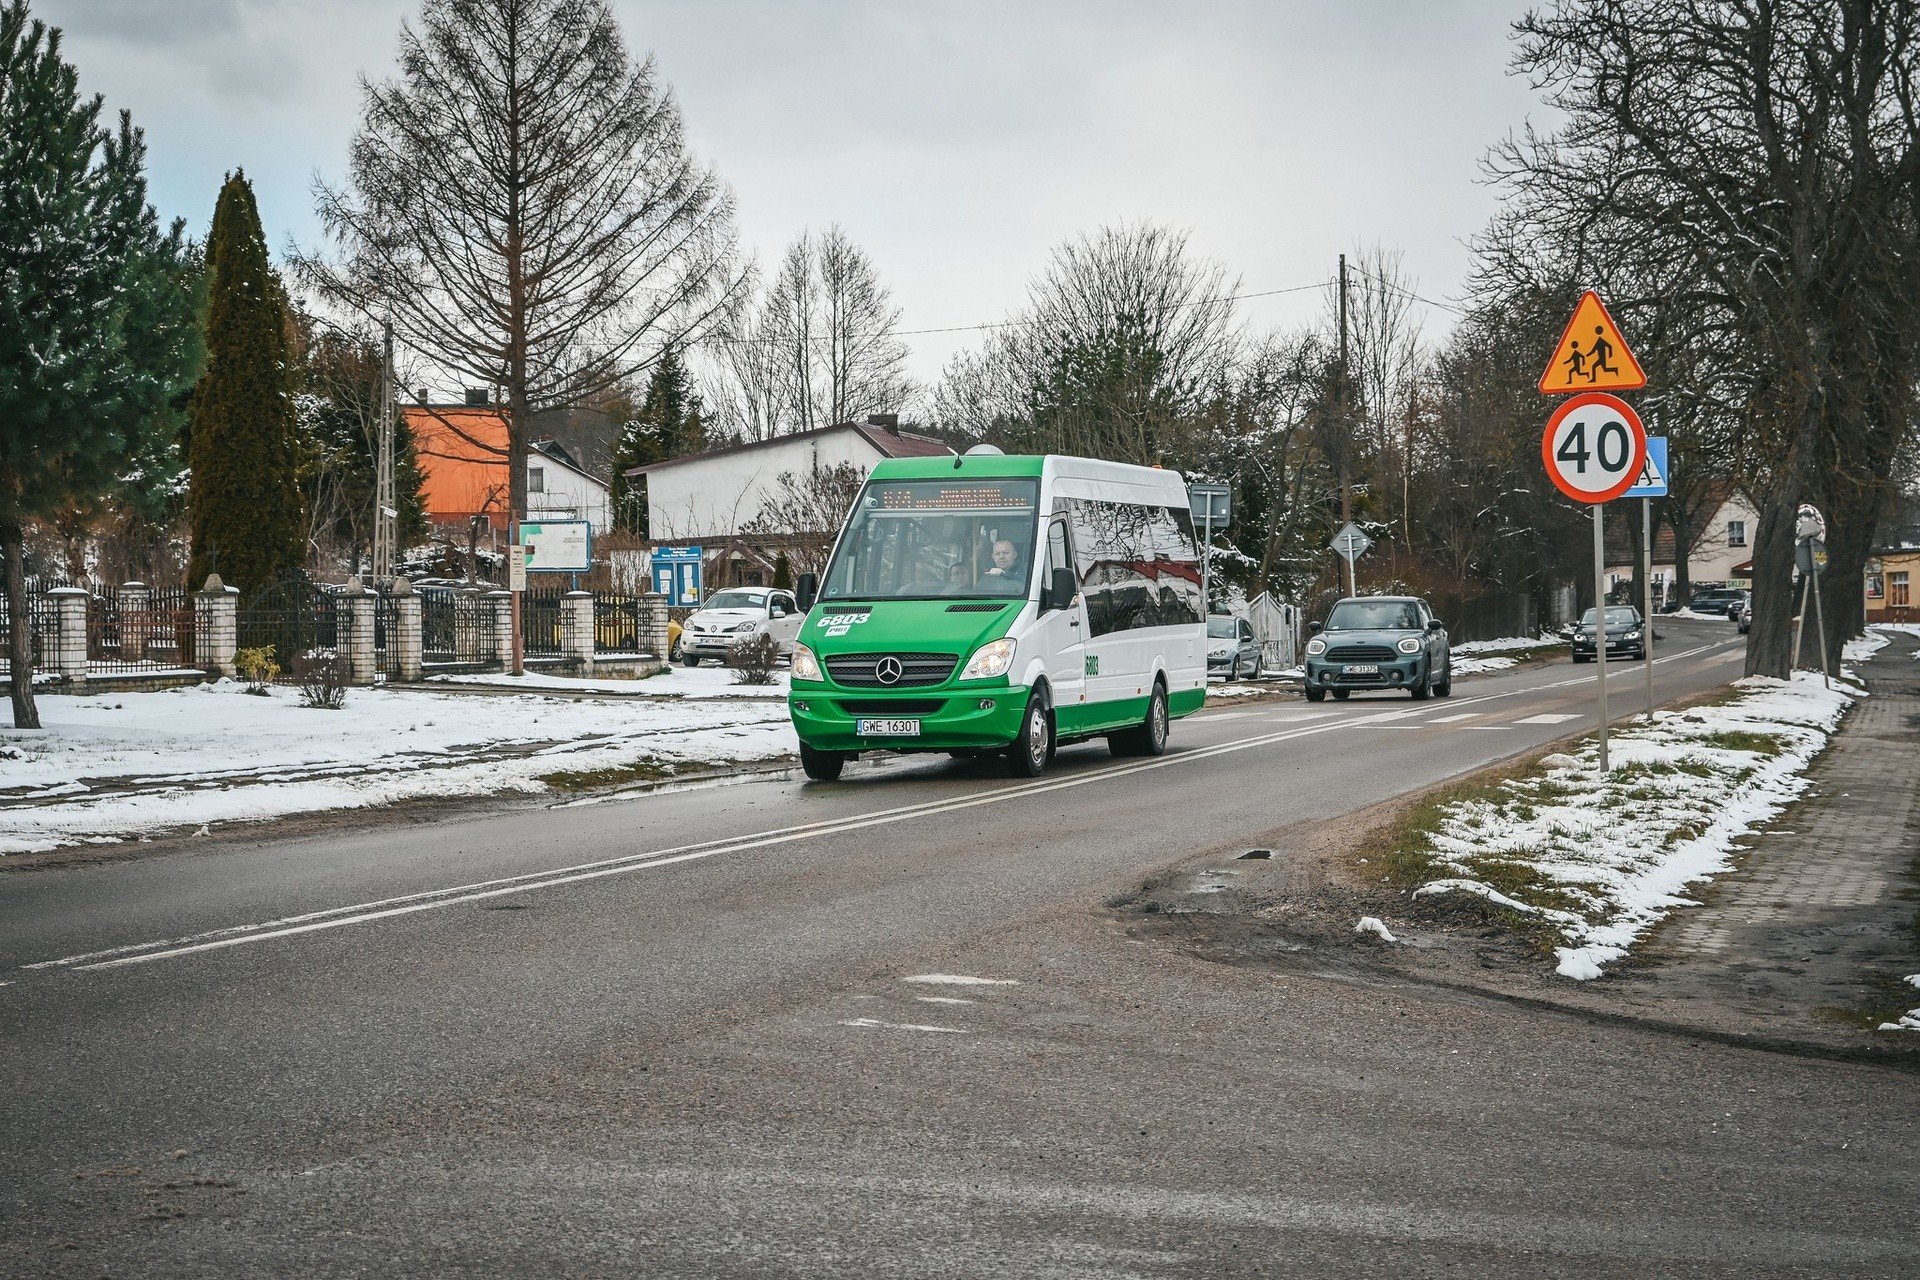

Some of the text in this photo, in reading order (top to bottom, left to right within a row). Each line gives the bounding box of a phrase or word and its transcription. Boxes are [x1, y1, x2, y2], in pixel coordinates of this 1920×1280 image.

[1557, 421, 1629, 473] 40
[817, 614, 870, 627] 6803
[1085, 654, 1099, 676] 6803
[862, 720, 918, 732] GWE 1630T
